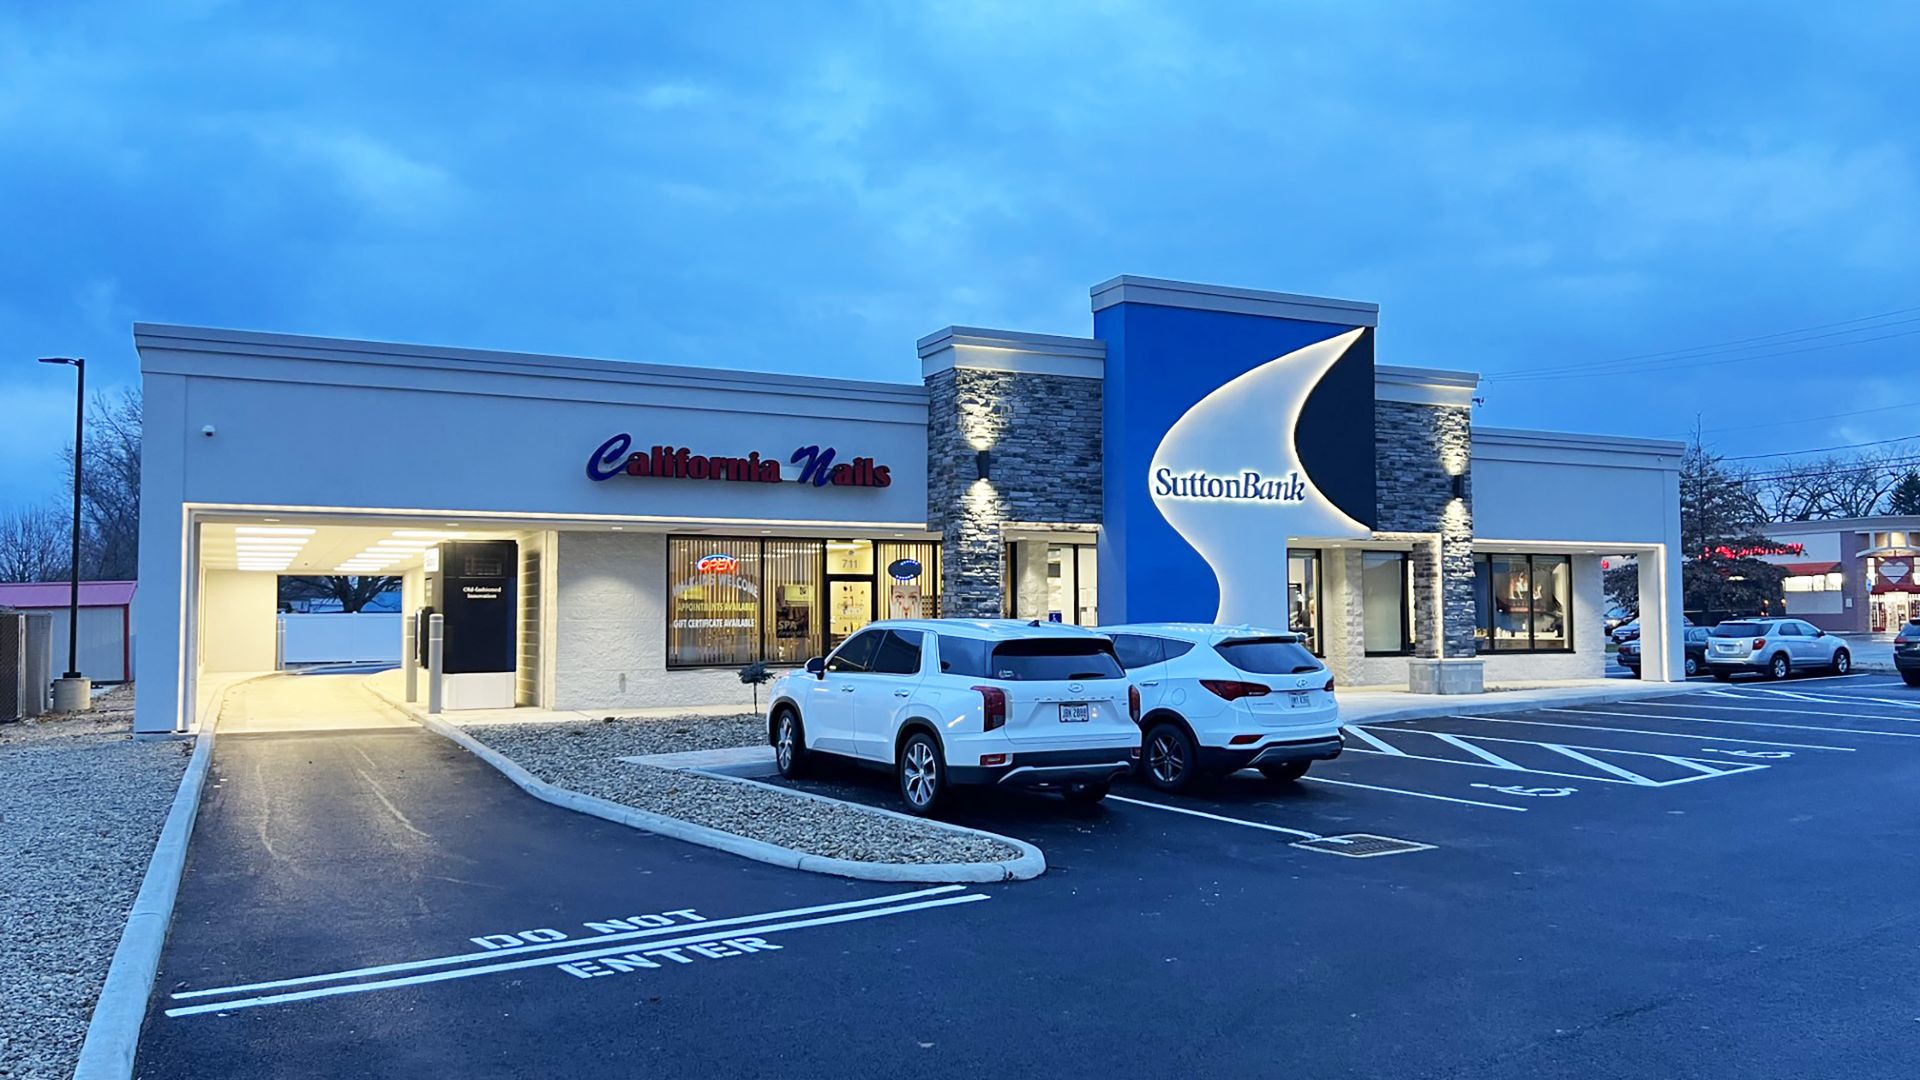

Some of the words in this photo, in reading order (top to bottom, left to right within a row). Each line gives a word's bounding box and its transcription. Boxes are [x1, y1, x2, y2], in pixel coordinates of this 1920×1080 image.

[586, 432, 783, 482] California
[790, 445, 892, 487] Nails
[1156, 467, 1305, 501] SuttonBank
[700, 558, 737, 573] OPEN
[718, 573, 758, 598] WELCOME
[673, 619, 687, 629] GIFT
[724, 619, 755, 628] AVAILABLE
[469, 928, 568, 950] DO
[583, 908, 707, 934] NOT
[557, 937, 784, 979] ENTER
